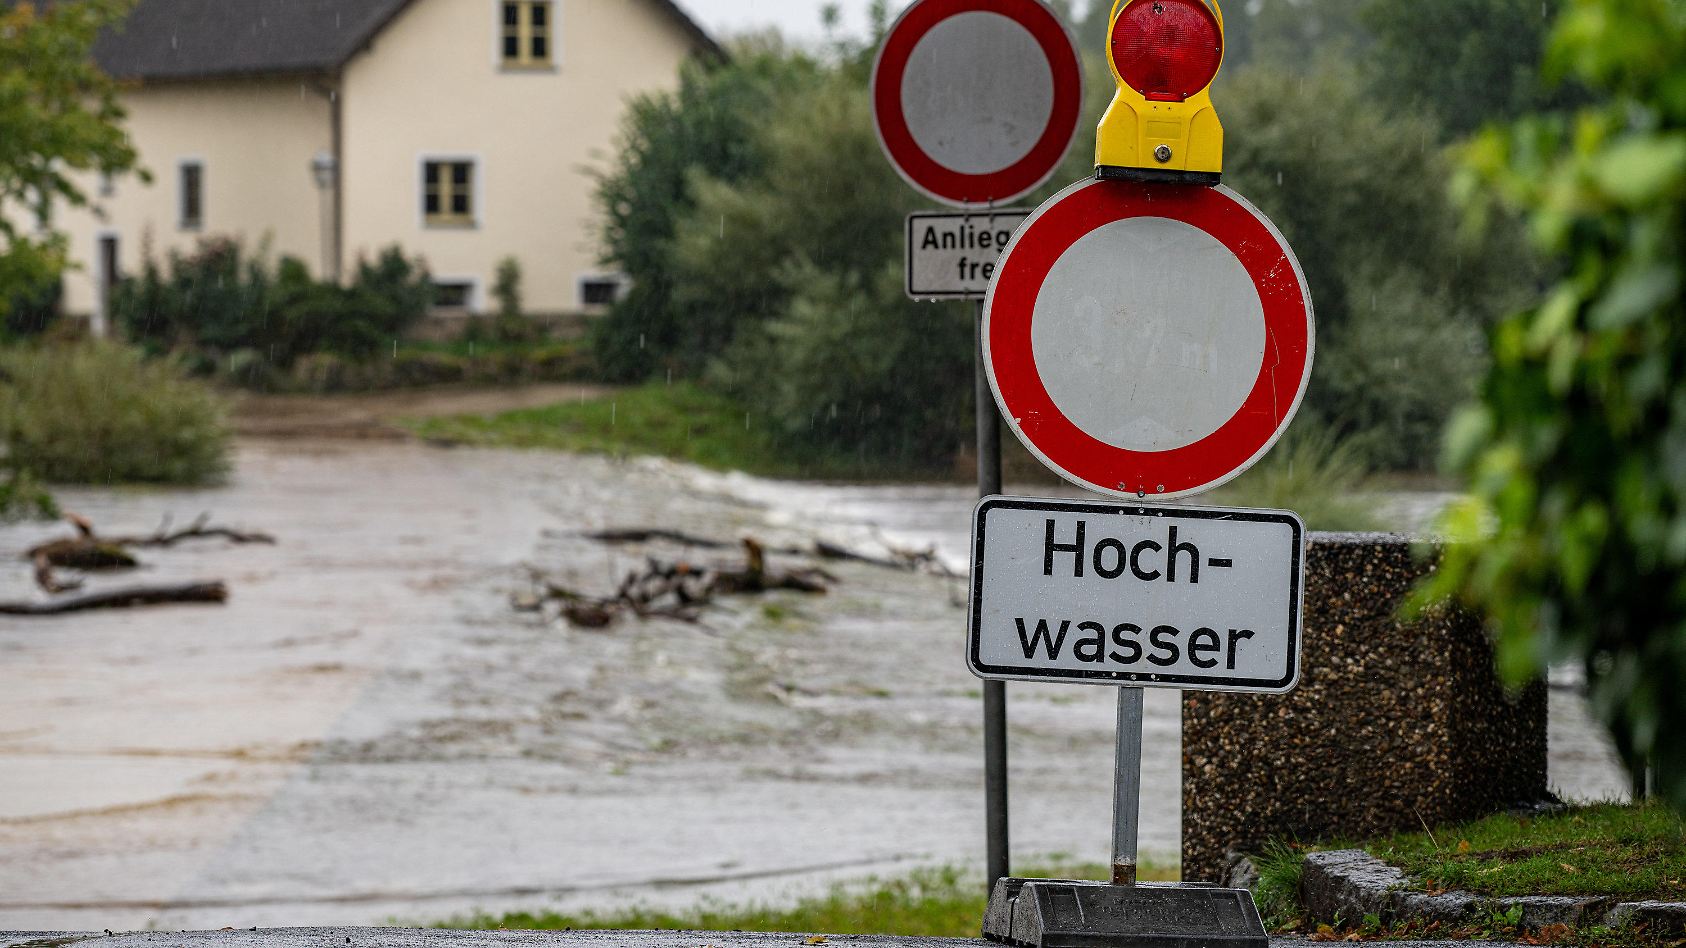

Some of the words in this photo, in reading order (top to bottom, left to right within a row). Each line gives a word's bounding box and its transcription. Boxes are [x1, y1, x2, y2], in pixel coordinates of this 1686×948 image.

[921, 225, 1010, 253] Anlieg
[957, 257, 995, 281] fre
[1043, 519, 1233, 584] Hoch-
[1014, 617, 1256, 670] wasser
